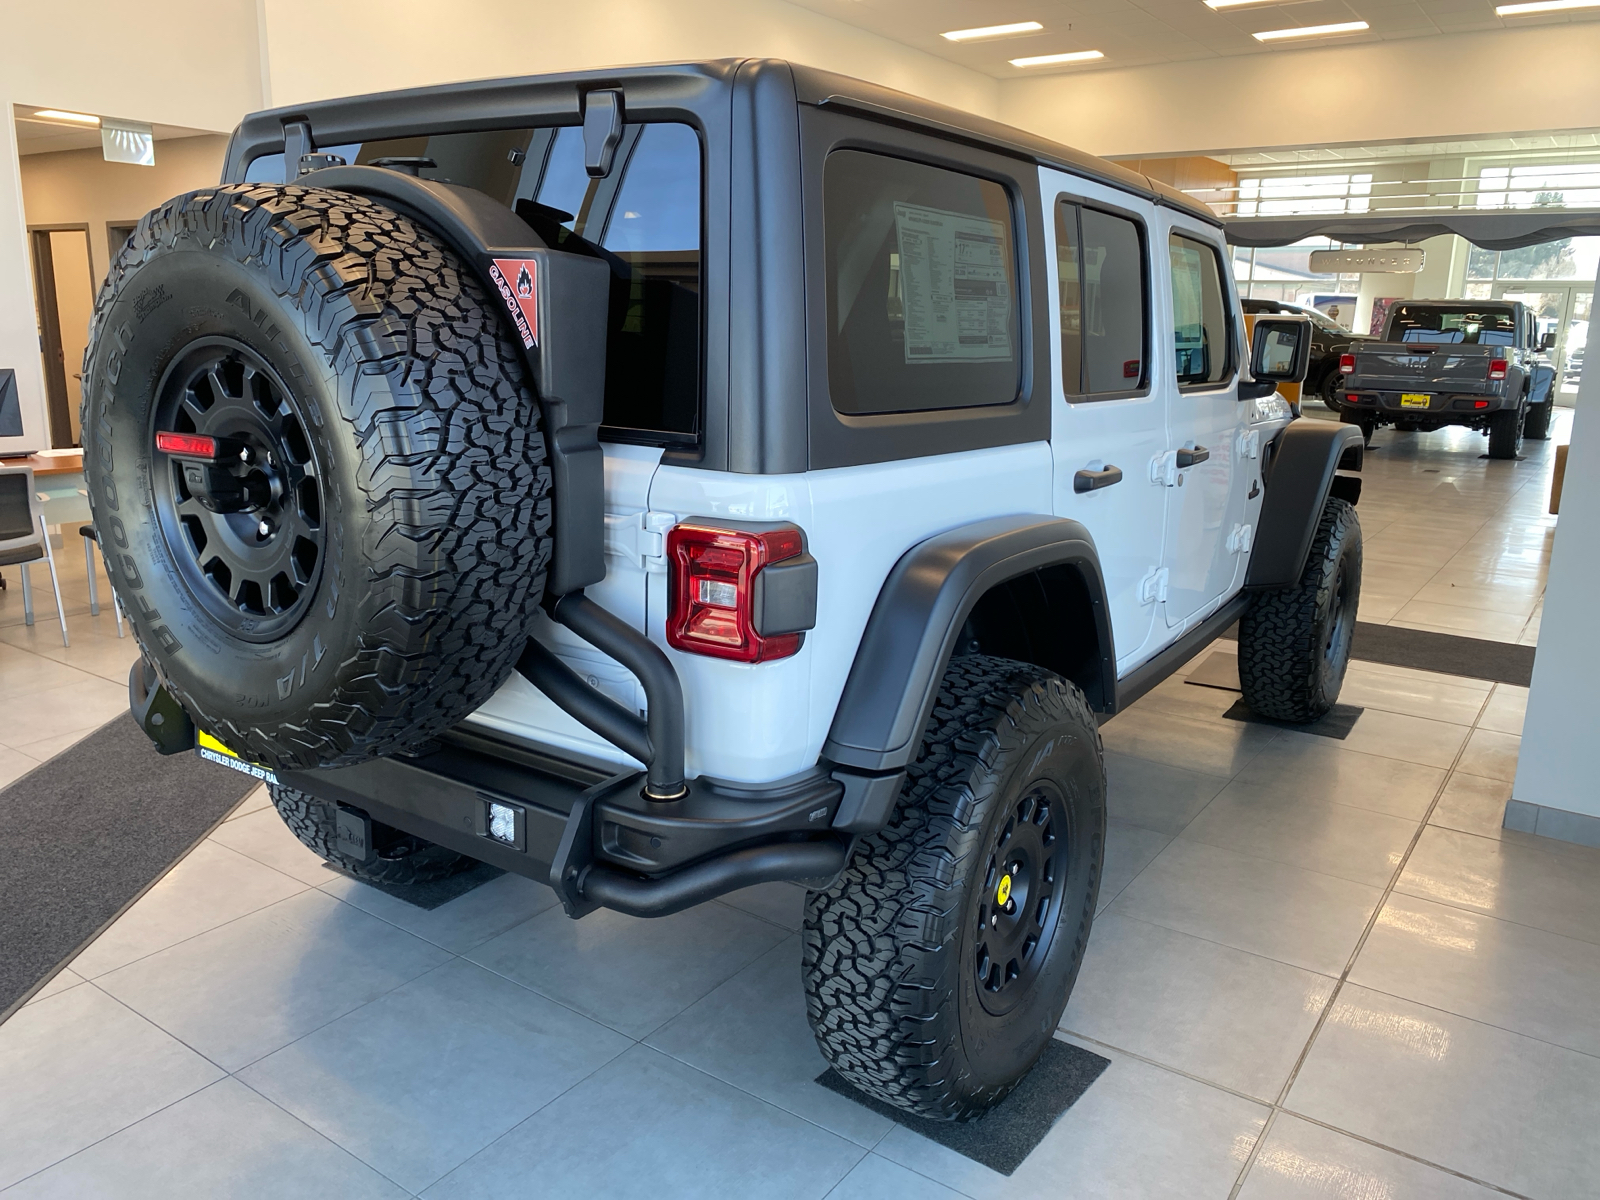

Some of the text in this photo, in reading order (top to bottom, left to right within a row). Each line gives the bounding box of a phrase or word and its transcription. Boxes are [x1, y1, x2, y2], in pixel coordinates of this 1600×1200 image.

[489, 265, 535, 350] GASOLINE
[96, 320, 183, 657] BFGoodrich
[277, 632, 328, 700] T/A
[200, 748, 230, 768] CHRYSLER
[230, 759, 251, 775] DODGE
[251, 767, 266, 779] JEEP
